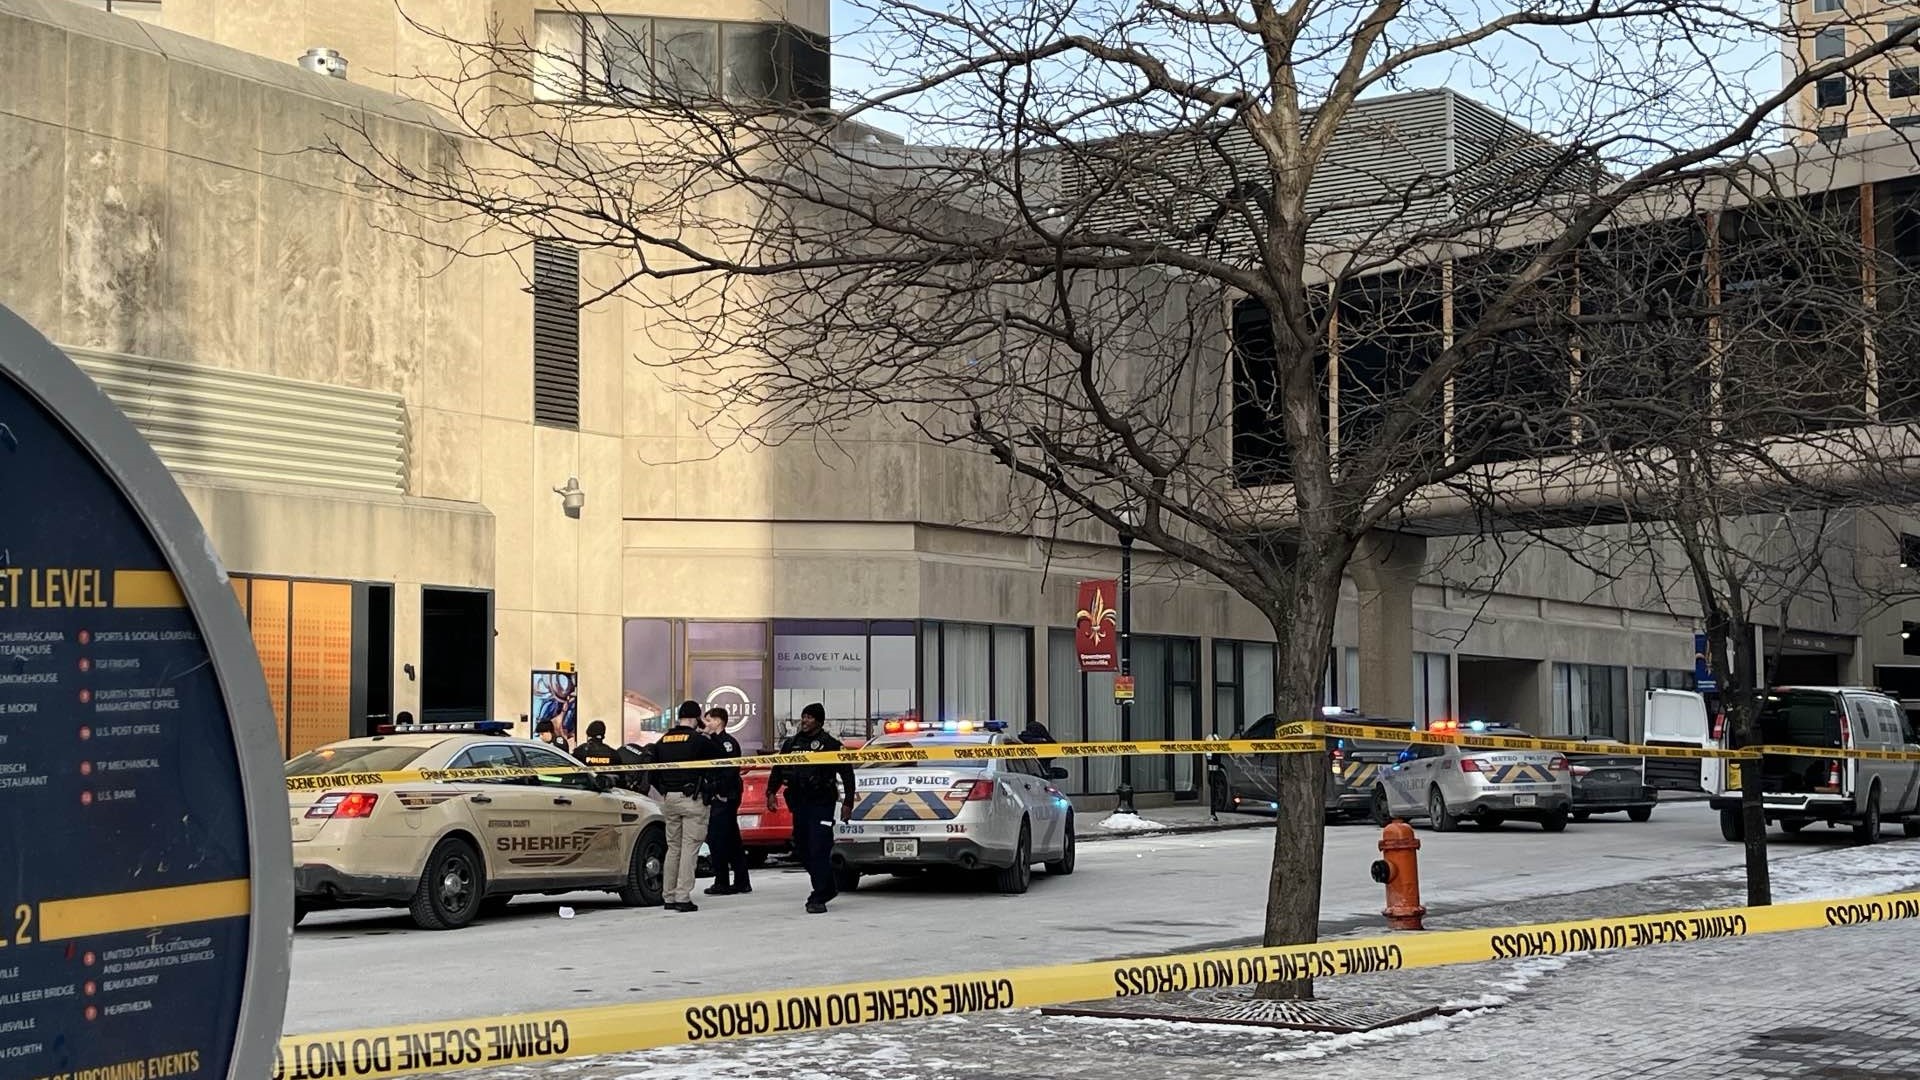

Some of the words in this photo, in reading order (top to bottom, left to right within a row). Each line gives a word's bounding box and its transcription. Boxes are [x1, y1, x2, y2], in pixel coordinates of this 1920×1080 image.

[31, 568, 107, 608] LEVEL
[8, 703, 38, 713] MOON
[725, 703, 756, 715] SPIRE
[133, 724, 160, 734] OFFICE
[287, 777, 317, 791] SCENE
[318, 776, 331, 788] DO
[333, 775, 350, 787] NOT
[352, 773, 383, 785] CROSS
[858, 776, 897, 787] METRO
[908, 775, 950, 786] POLICE
[496, 836, 582, 851] SHERIFF
[945, 824, 965, 834] 911
[15, 904, 32, 945] 2
[1191, 958, 1231, 989] NOT
[1237, 957, 1267, 985] DO
[1271, 949, 1335, 983] SCENE
[1340, 944, 1402, 975] CRIME
[21, 989, 43, 1002] BEER
[44, 984, 75, 999] BRIDGE
[1114, 962, 1188, 997] CROSS
[827, 992, 860, 1027] DO
[864, 986, 937, 1023] SCENE
[941, 979, 1014, 1015] CRIME
[685, 1001, 769, 1040] CROSS
[773, 996, 822, 1032] NOT
[7, 1043, 42, 1058] FOURTH
[352, 1037, 390, 1074] DO
[396, 1028, 481, 1070] SCENE
[486, 1019, 570, 1061] CRIME
[148, 1050, 200, 1080] EVENTS
[289, 1041, 347, 1080] NOT
